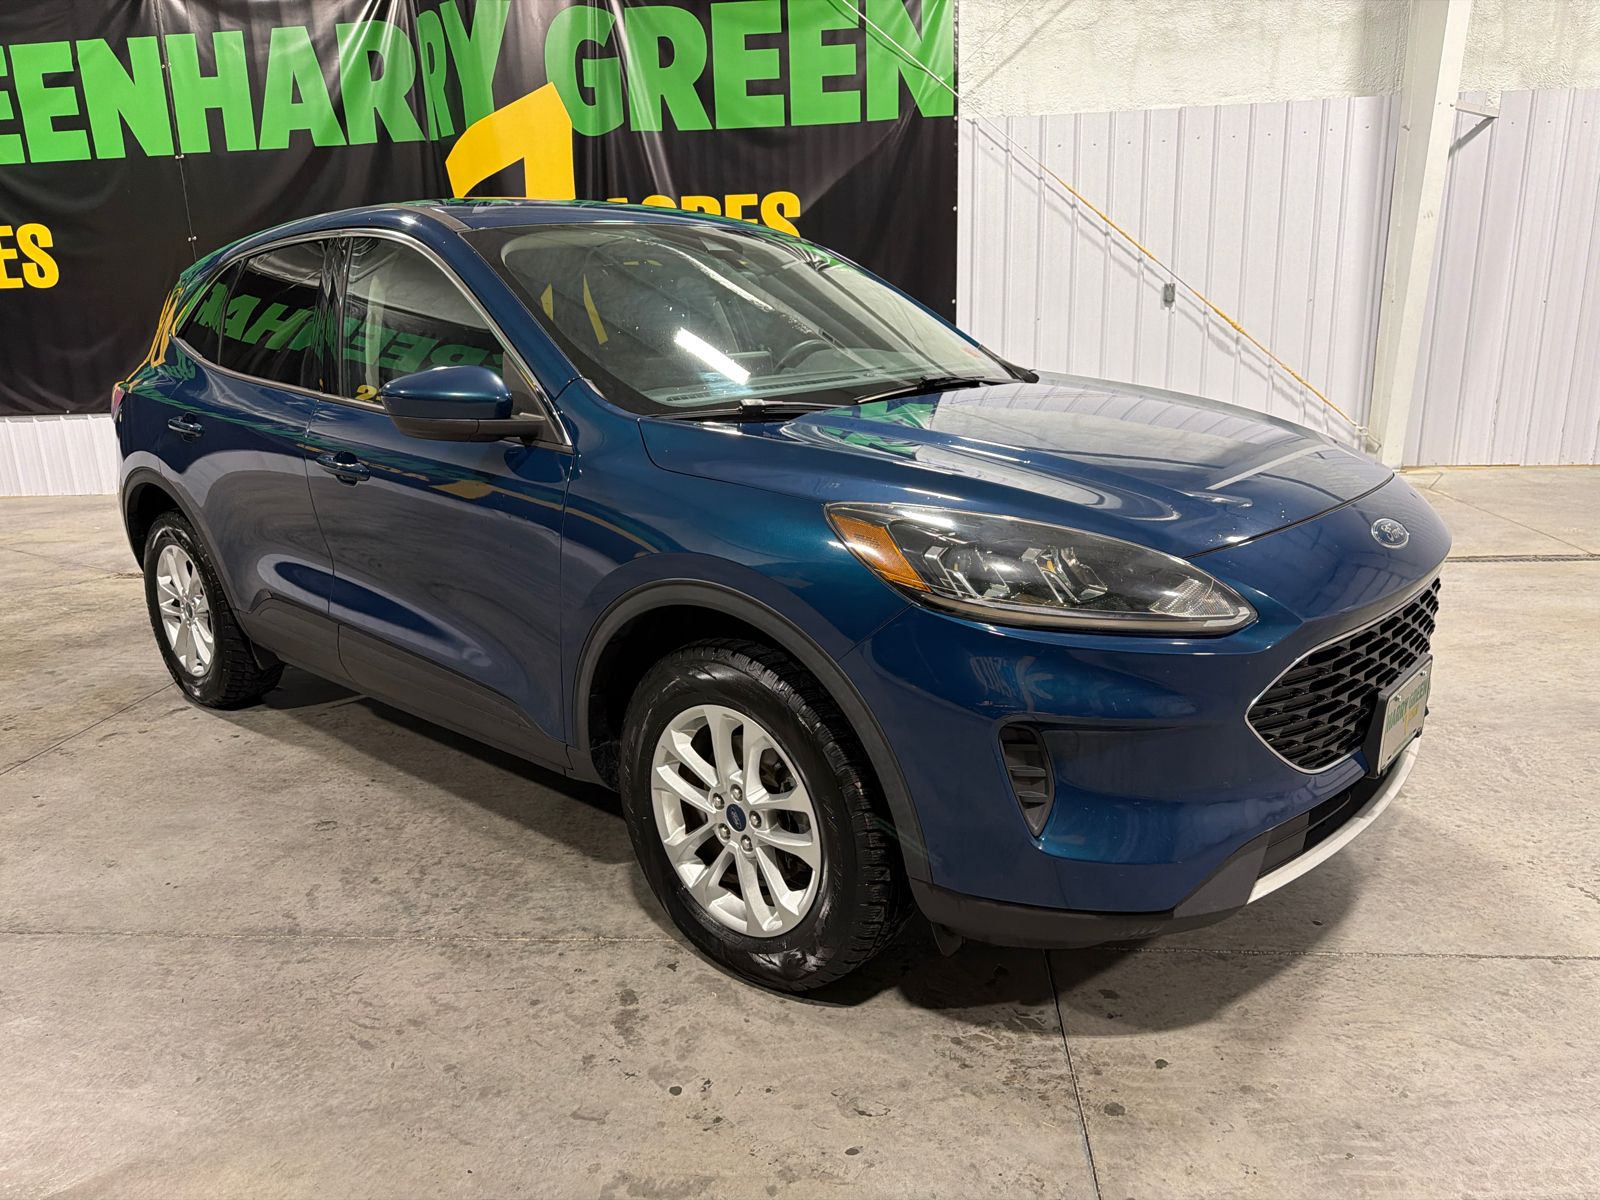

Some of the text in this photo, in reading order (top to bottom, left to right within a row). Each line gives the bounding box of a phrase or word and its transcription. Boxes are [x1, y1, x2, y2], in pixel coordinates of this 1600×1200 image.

[165, 0, 954, 153] HARRY GREEN
[1380, 522, 1404, 542] Ford
[1385, 696, 1409, 734] HARRY
[1409, 680, 1429, 708] GREEN
